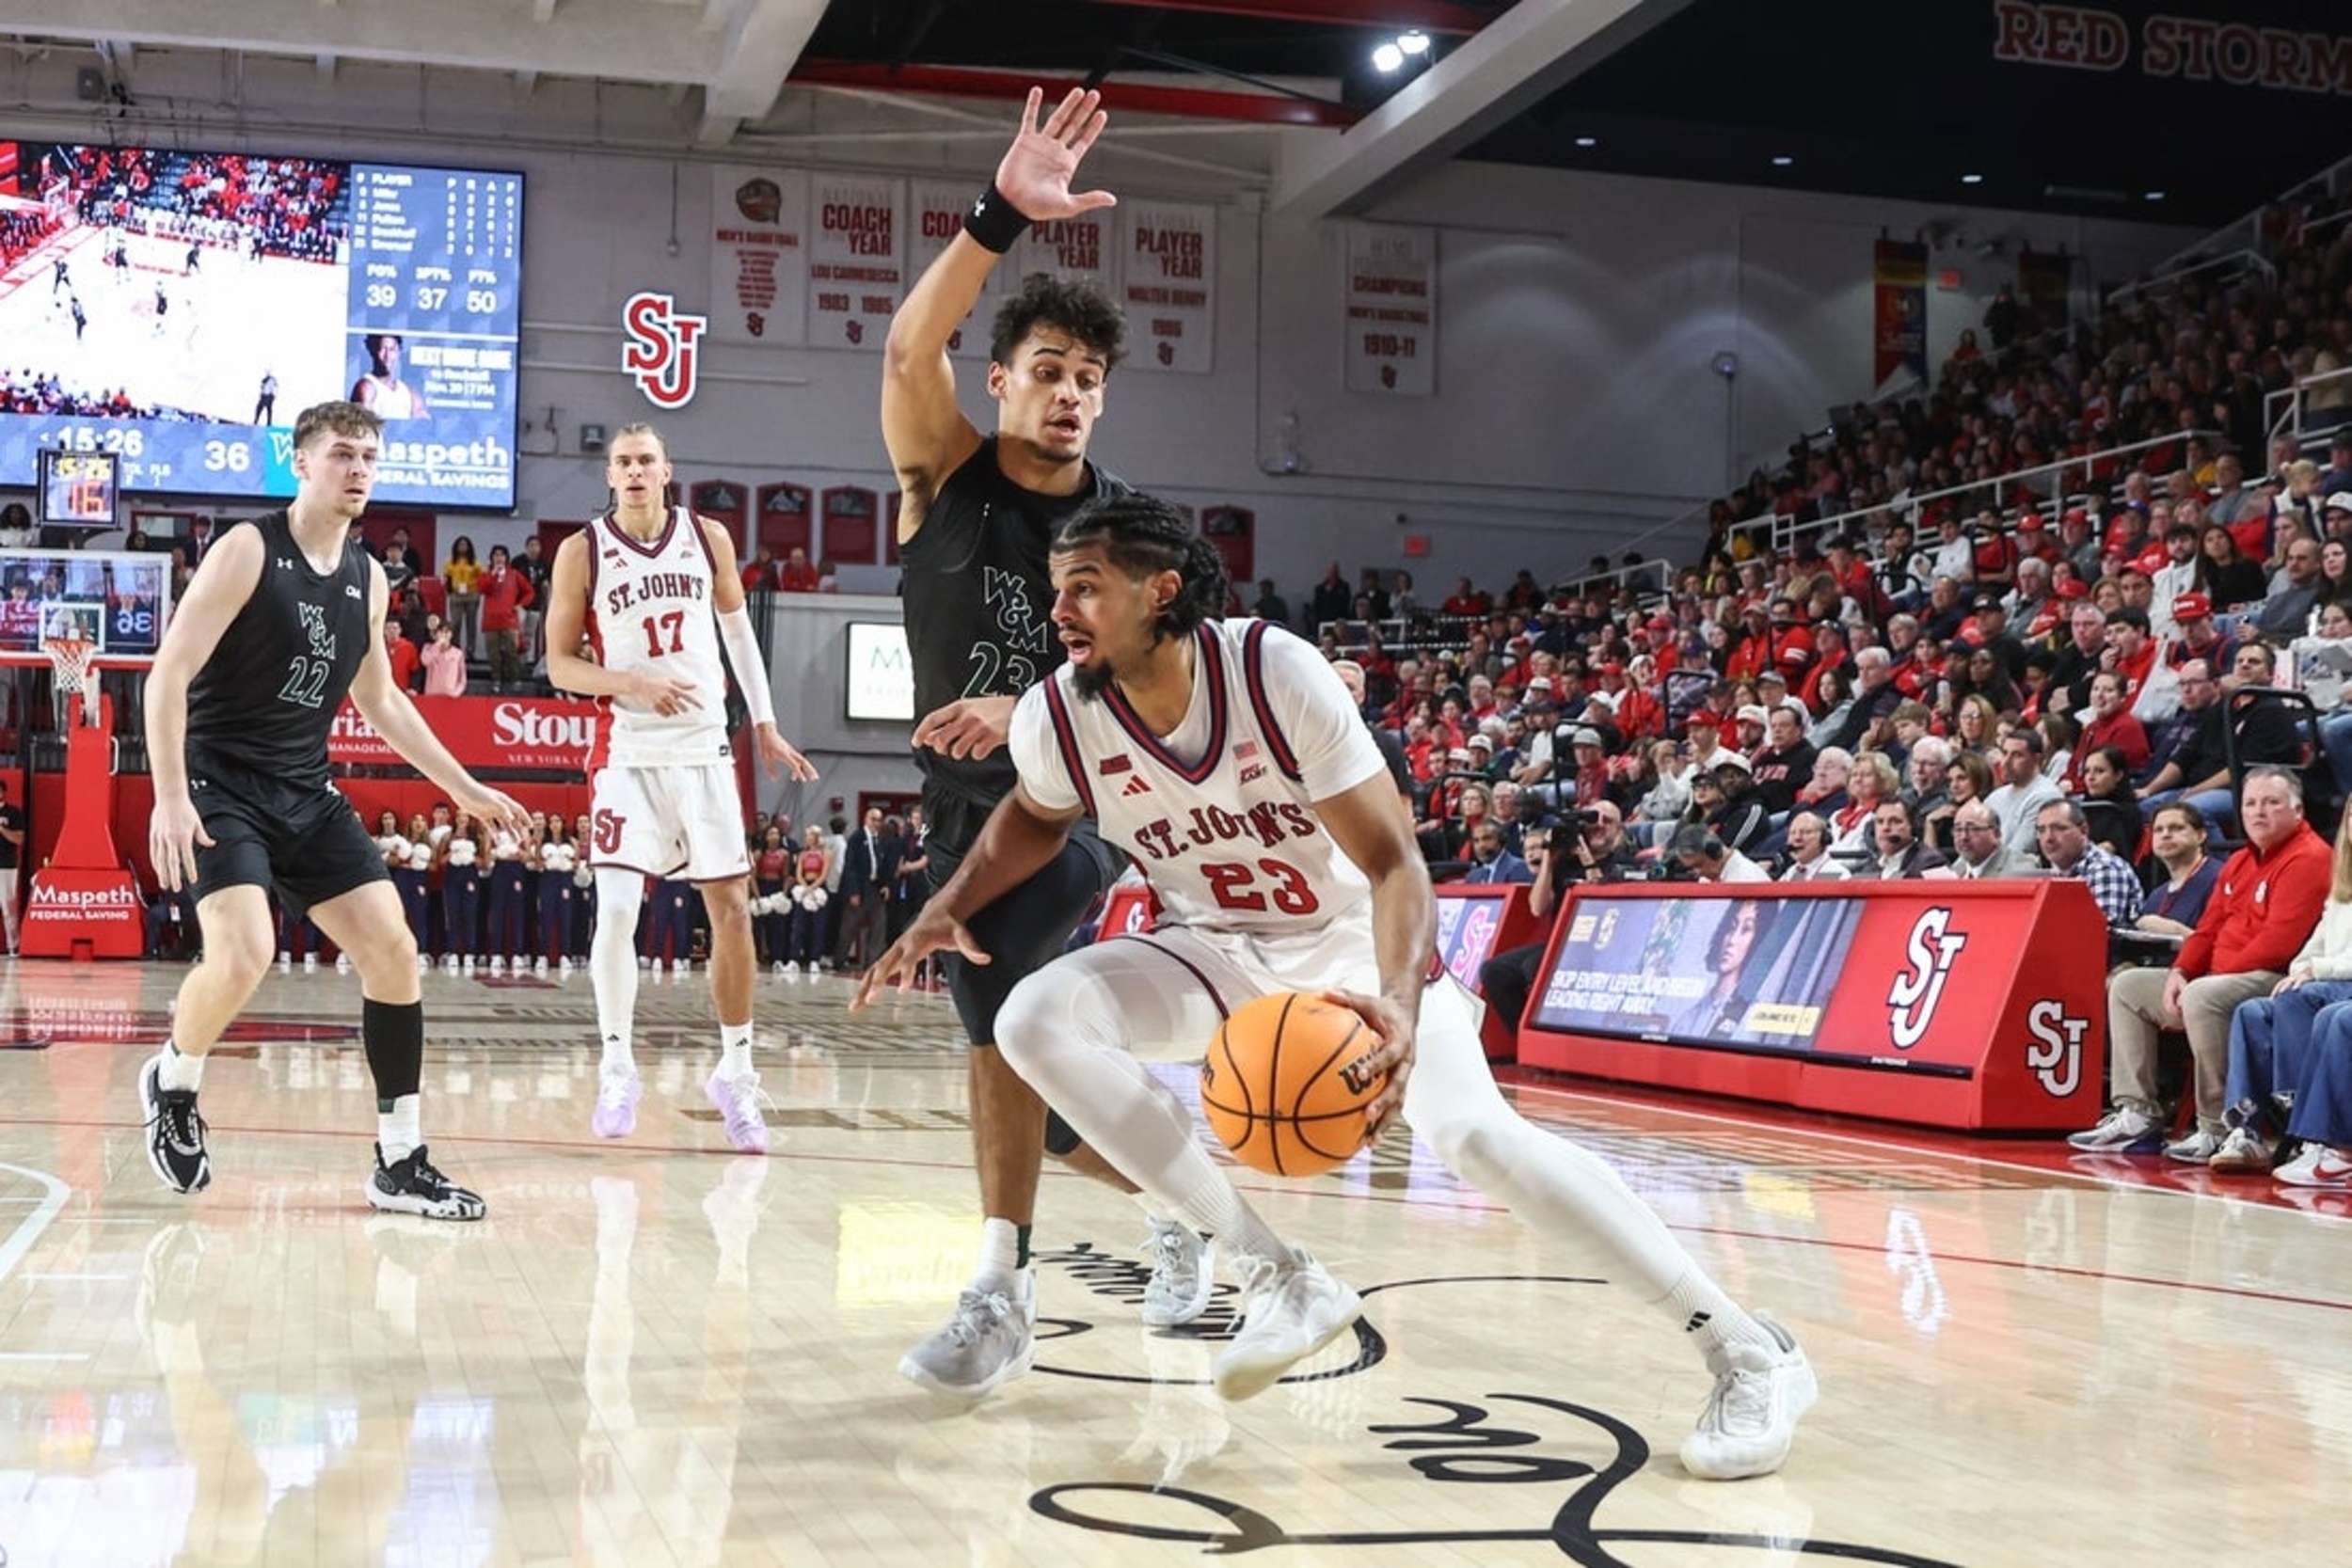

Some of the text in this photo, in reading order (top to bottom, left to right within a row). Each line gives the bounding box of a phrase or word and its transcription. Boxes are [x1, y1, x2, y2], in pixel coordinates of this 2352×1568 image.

[1994, 2, 2352, 95] RED STORM
[822, 204, 892, 233] COACH
[922, 211, 962, 239] COA
[1031, 220, 1099, 246] PLAYER
[849, 234, 892, 257] YEAR
[1136, 228, 1203, 256] PLAYER
[1057, 246, 1099, 270] YEAR
[1161, 256, 1202, 280] YEAR
[366, 284, 496, 313] 39 37 50
[57, 427, 143, 456] 15:26
[204, 440, 249, 471] 36
[638, 572, 705, 601] JOHN'S
[643, 610, 685, 657] 17
[278, 656, 330, 708] 22
[961, 641, 1037, 699] 23
[493, 703, 595, 747] Stou
[32, 885, 135, 910] Maspeth
[1200, 857, 1319, 915] 23
[30, 911, 83, 921] FEDERAL
